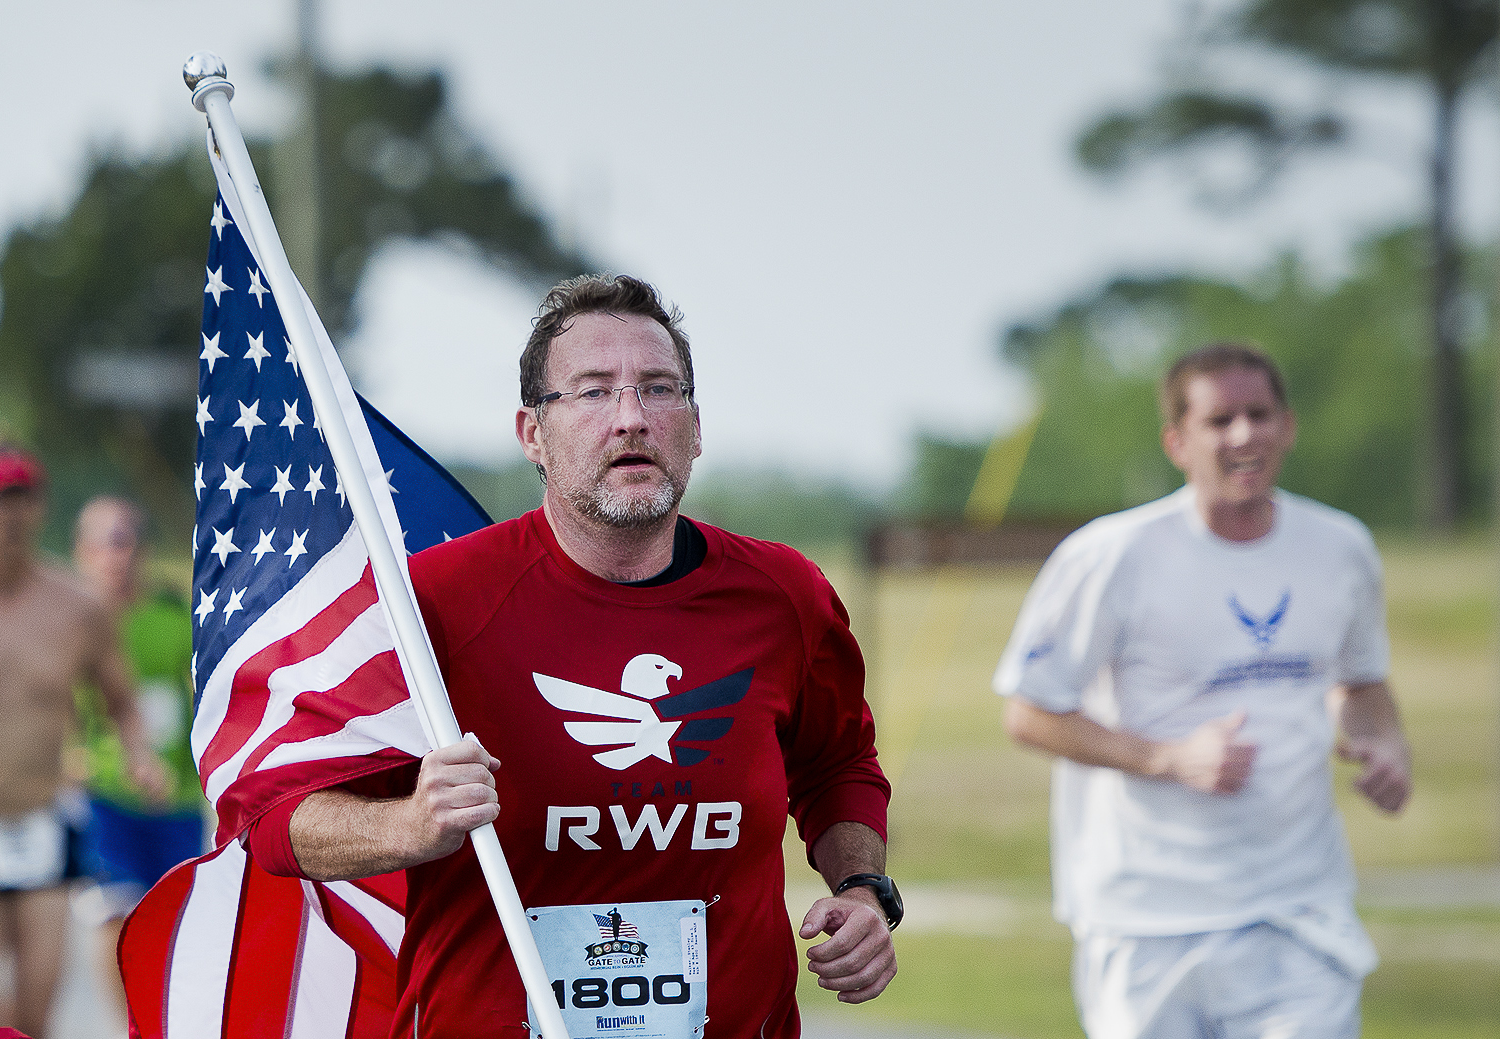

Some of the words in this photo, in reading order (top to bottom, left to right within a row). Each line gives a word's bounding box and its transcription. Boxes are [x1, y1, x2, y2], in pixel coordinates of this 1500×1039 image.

[611, 781, 692, 797] TEAM
[545, 801, 742, 851] RWB
[588, 958, 613, 966] GATE
[621, 957, 646, 965] GATE
[550, 974, 690, 1009] 1800
[620, 1015, 638, 1025] with
